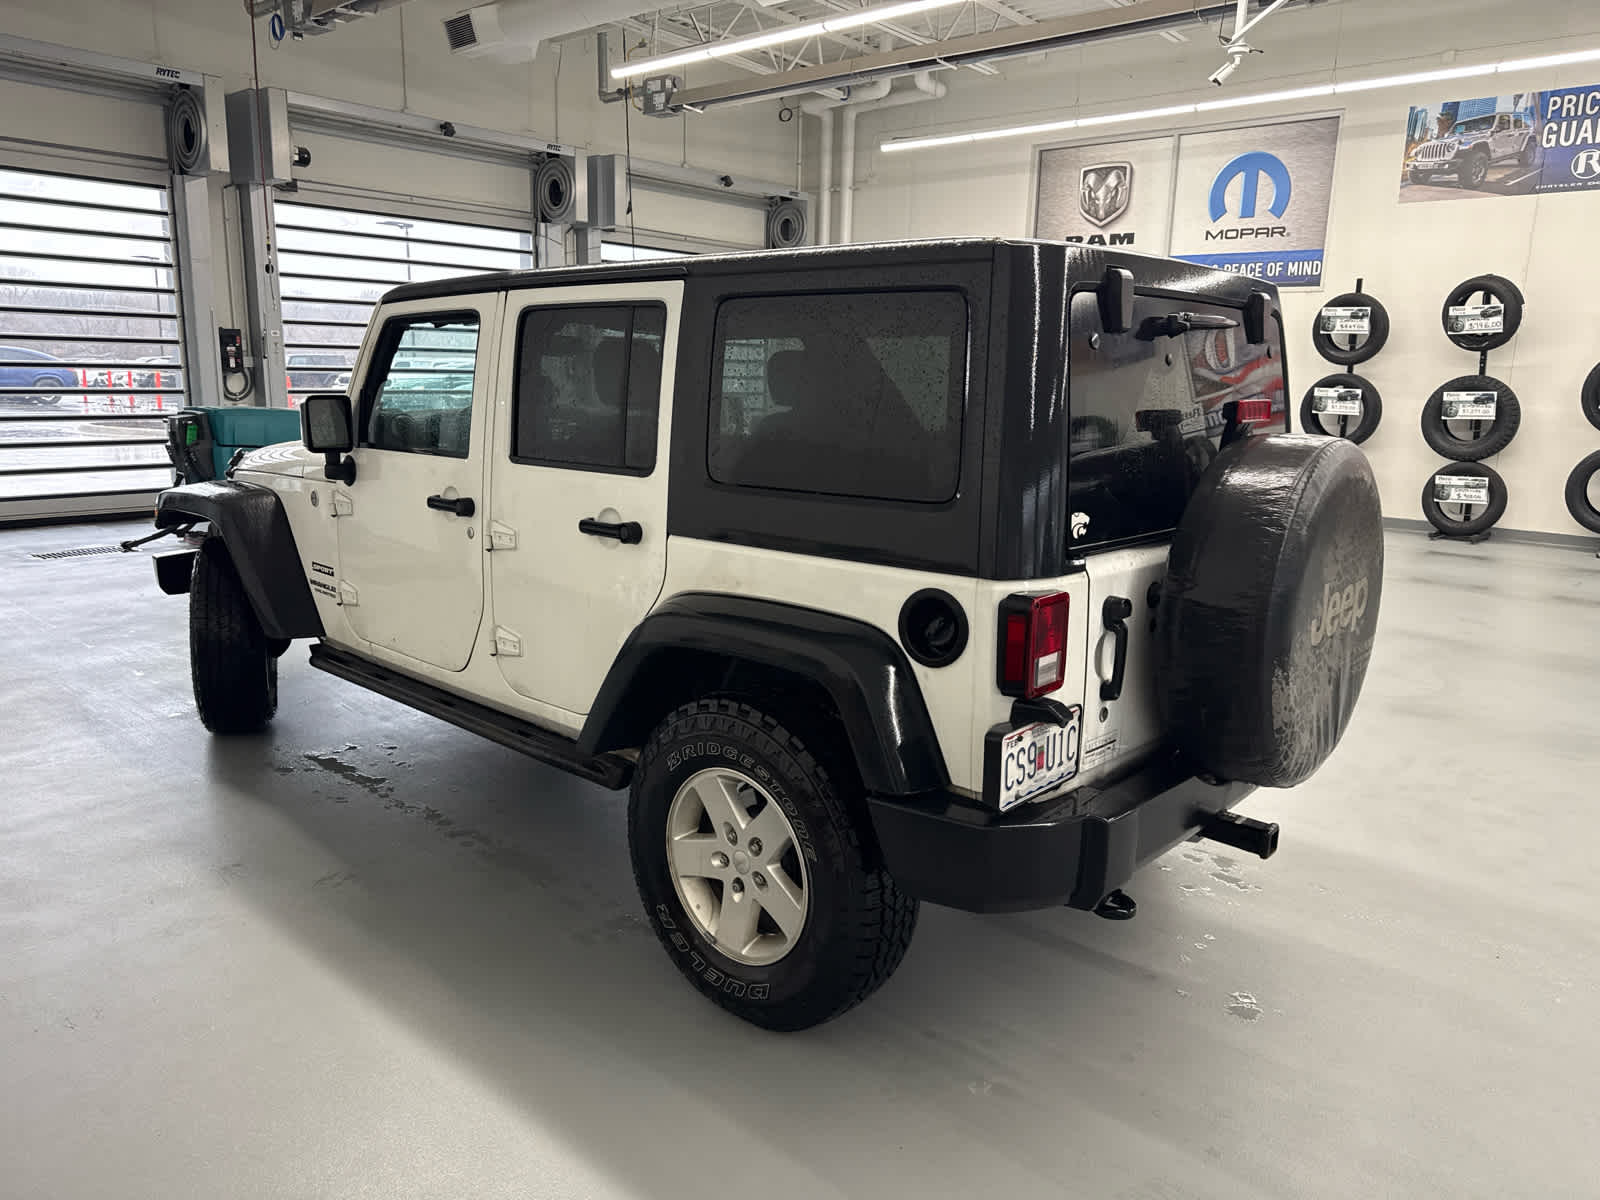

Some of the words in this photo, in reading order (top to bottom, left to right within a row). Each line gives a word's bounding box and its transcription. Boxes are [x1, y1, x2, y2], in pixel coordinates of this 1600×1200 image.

[156, 67, 181, 79] RYTEC
[1542, 118, 1600, 148] GUA
[1205, 226, 1287, 241] MOPAR
[1266, 262, 1284, 277] OF
[1287, 260, 1322, 276] MIND
[1311, 577, 1369, 646] Jeep
[1005, 741, 1037, 791] CS9
[665, 742, 818, 863] BRIDGESTONE
[656, 903, 770, 1000] DUELER
